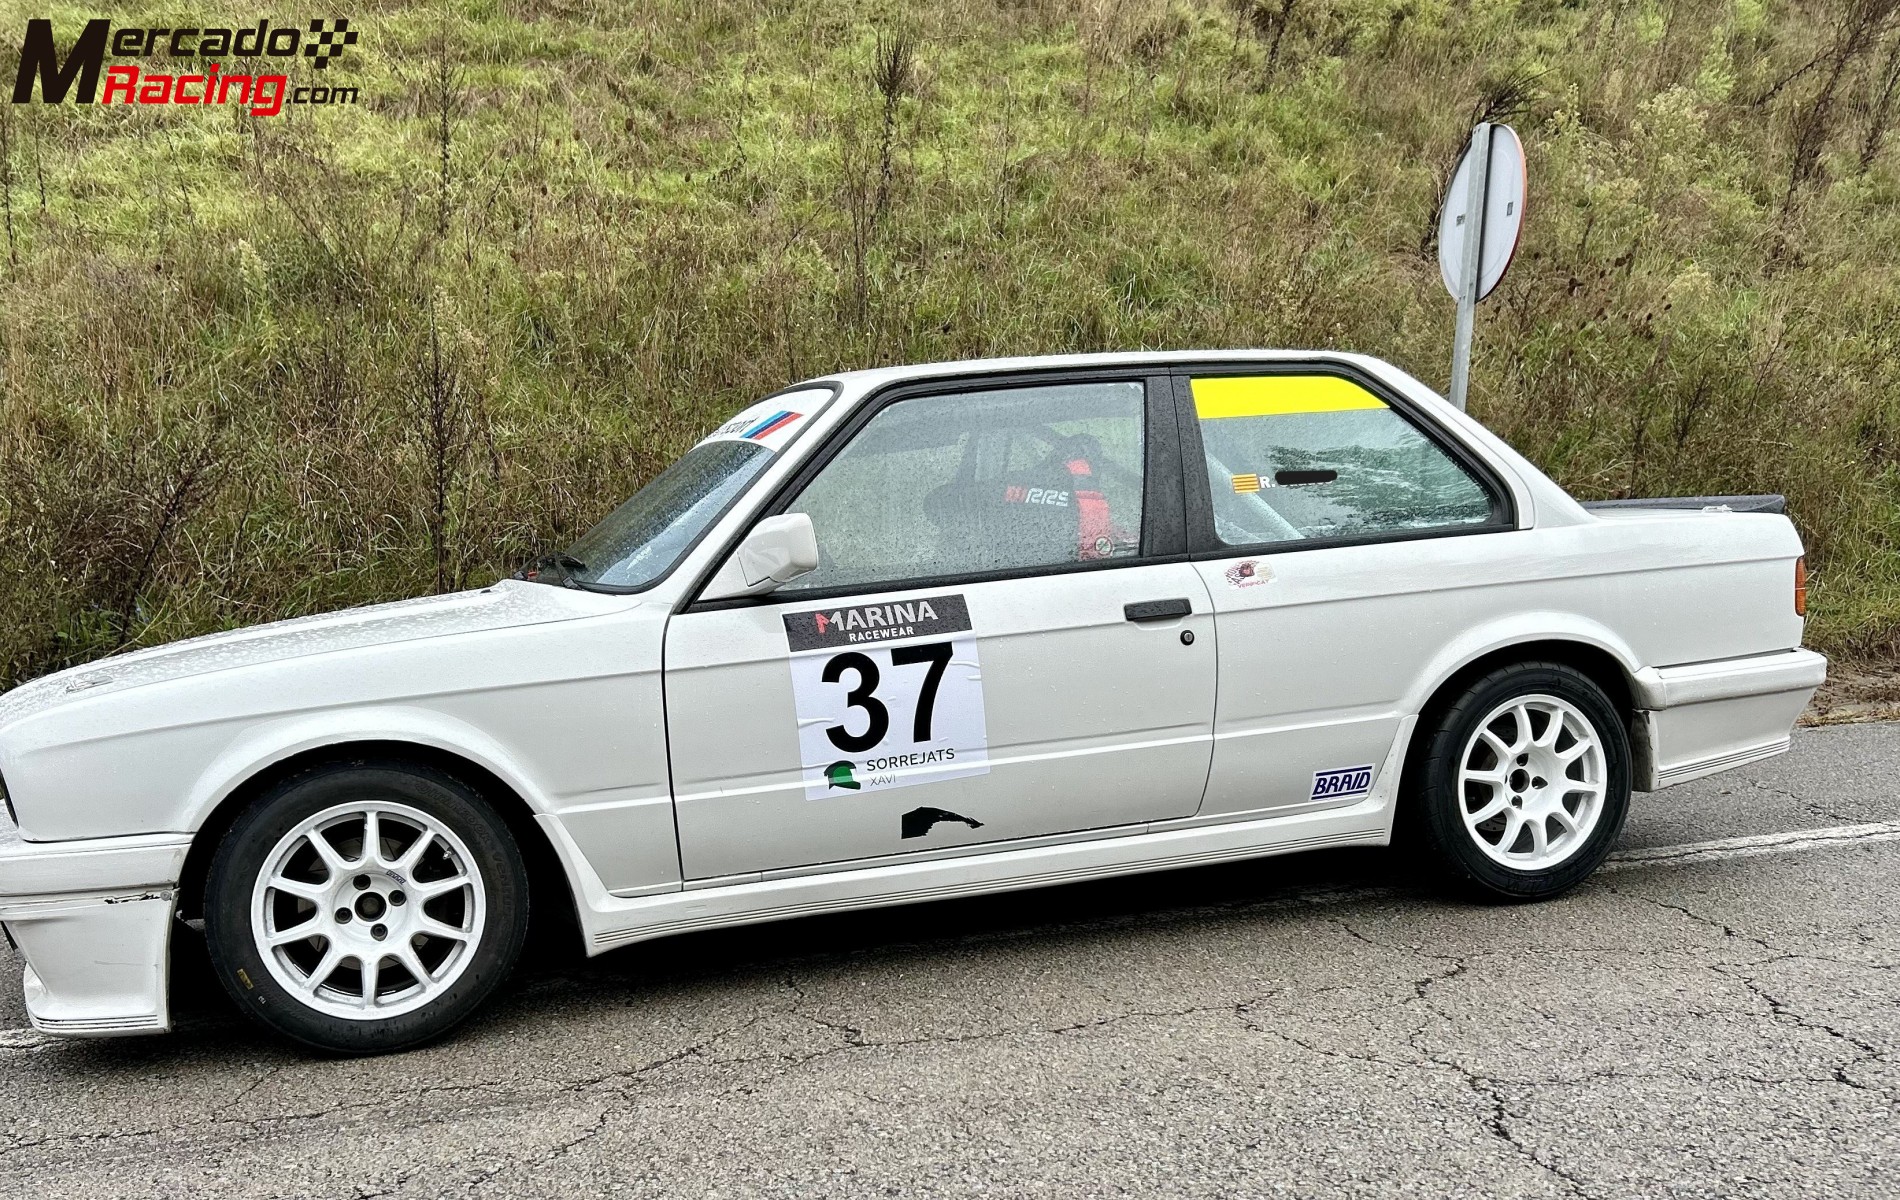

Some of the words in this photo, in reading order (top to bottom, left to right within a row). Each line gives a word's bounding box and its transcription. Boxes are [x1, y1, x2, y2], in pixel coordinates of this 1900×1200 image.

[815, 600, 938, 634] MARINA
[849, 626, 915, 643] RACEWEAR
[821, 641, 954, 753] 37
[866, 748, 955, 771] SORREJATS
[869, 774, 896, 787] XAVI
[1312, 771, 1371, 795] BRAID
